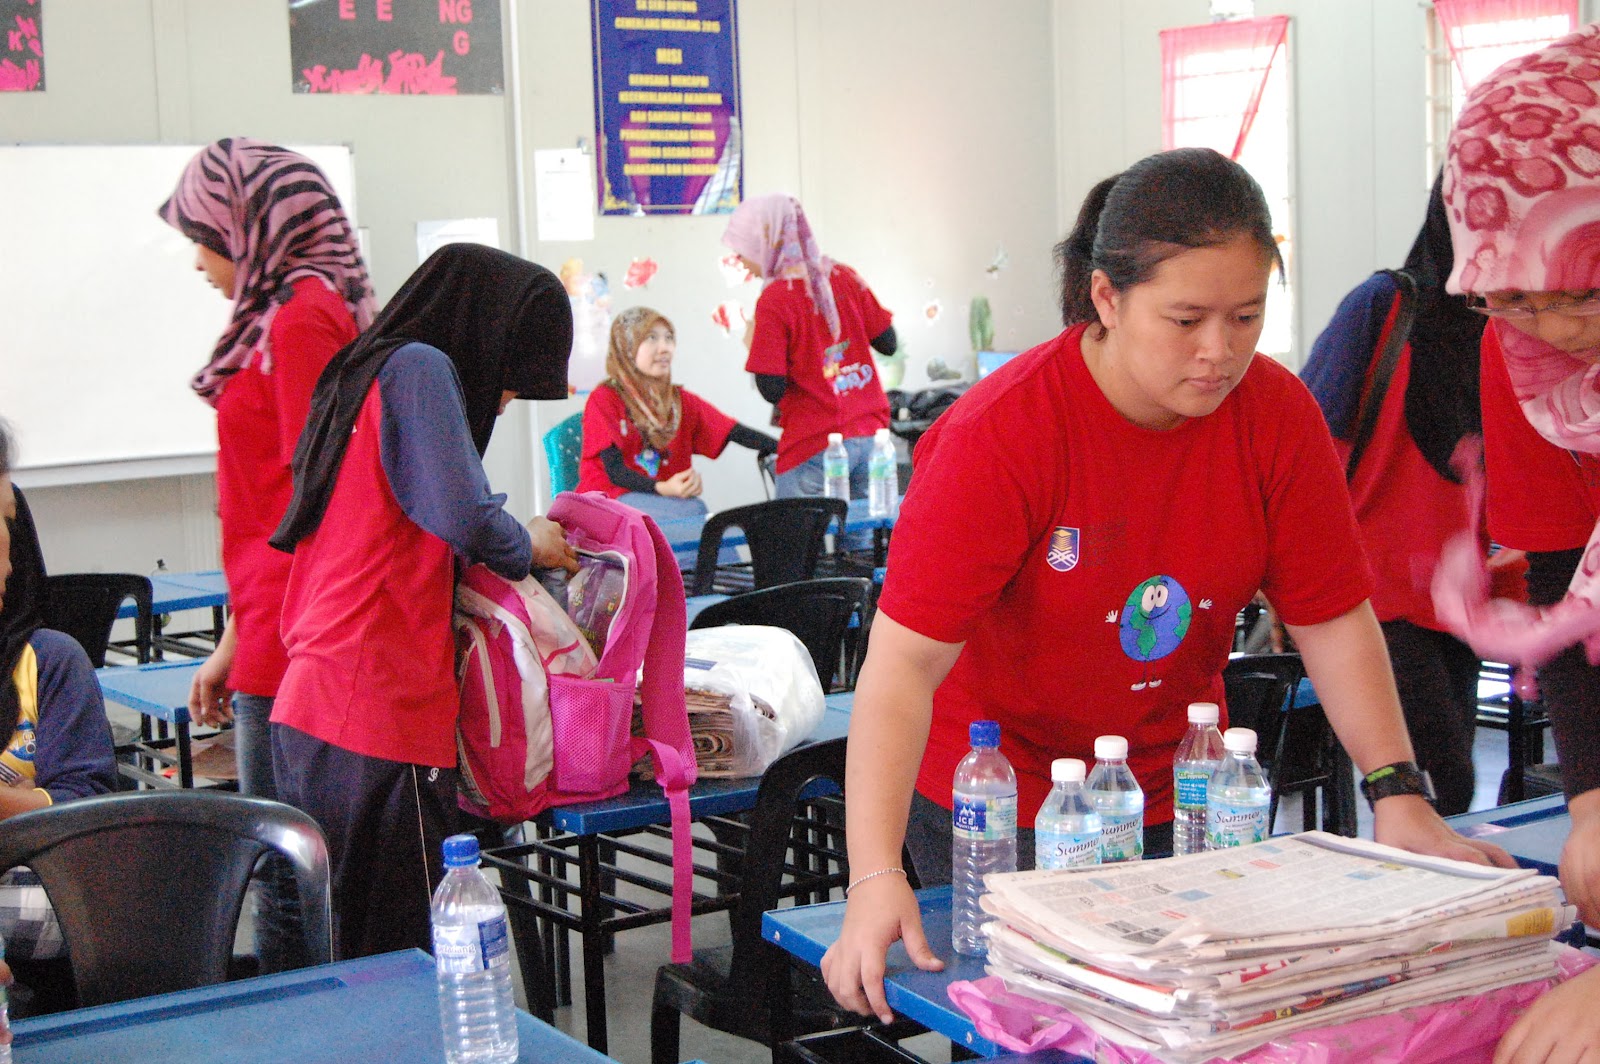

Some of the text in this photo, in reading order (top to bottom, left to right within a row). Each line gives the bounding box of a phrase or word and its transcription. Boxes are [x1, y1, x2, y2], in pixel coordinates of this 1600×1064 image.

[958, 816, 974, 826] ICE
[1214, 810, 1260, 824] Summer
[1055, 837, 1099, 857] Summer
